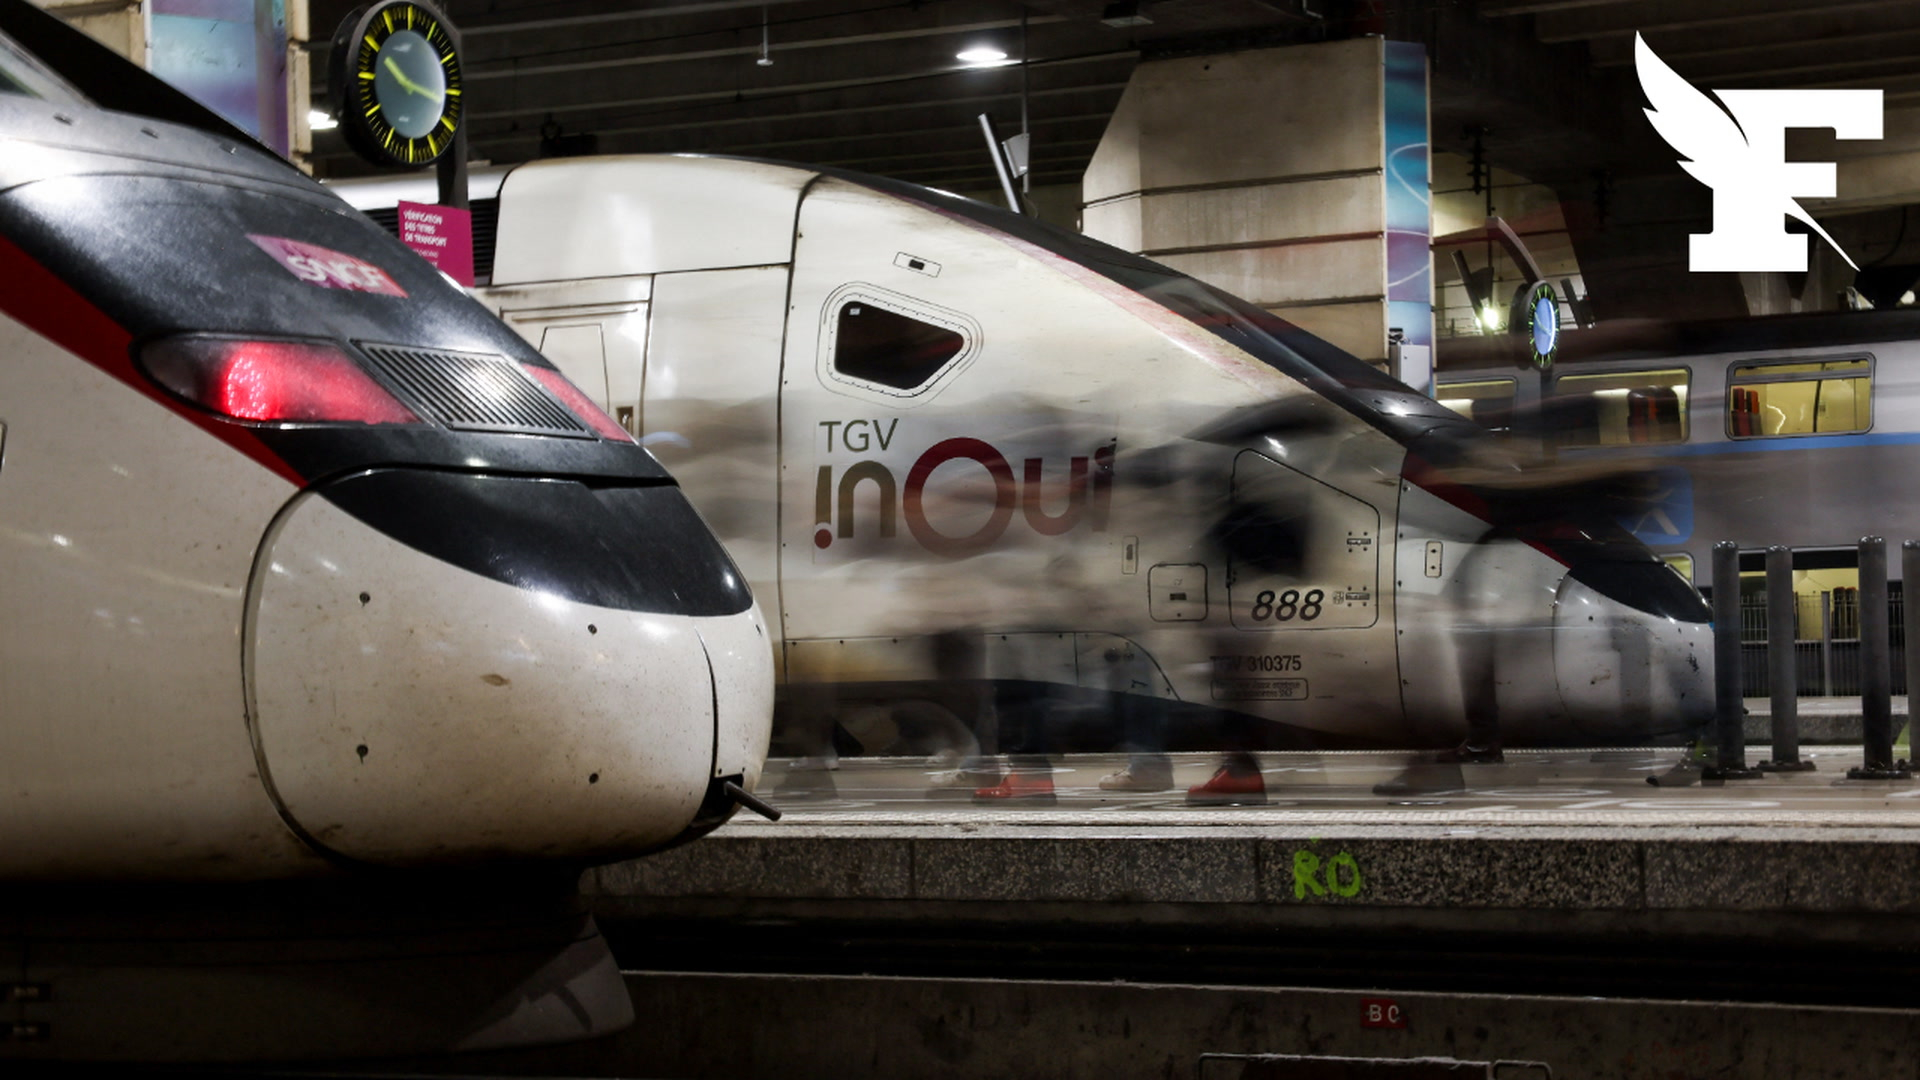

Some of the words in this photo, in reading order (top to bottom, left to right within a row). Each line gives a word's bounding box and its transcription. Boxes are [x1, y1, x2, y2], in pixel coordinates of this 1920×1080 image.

[404, 221, 416, 232] DES
[404, 232, 413, 242] DE
[414, 233, 448, 247] TRANSPORT
[286, 254, 382, 287] SNCF
[819, 418, 899, 453] TGV
[1251, 588, 1325, 622] 888
[1248, 654, 1302, 671] 310375
[1293, 849, 1361, 899] RO
